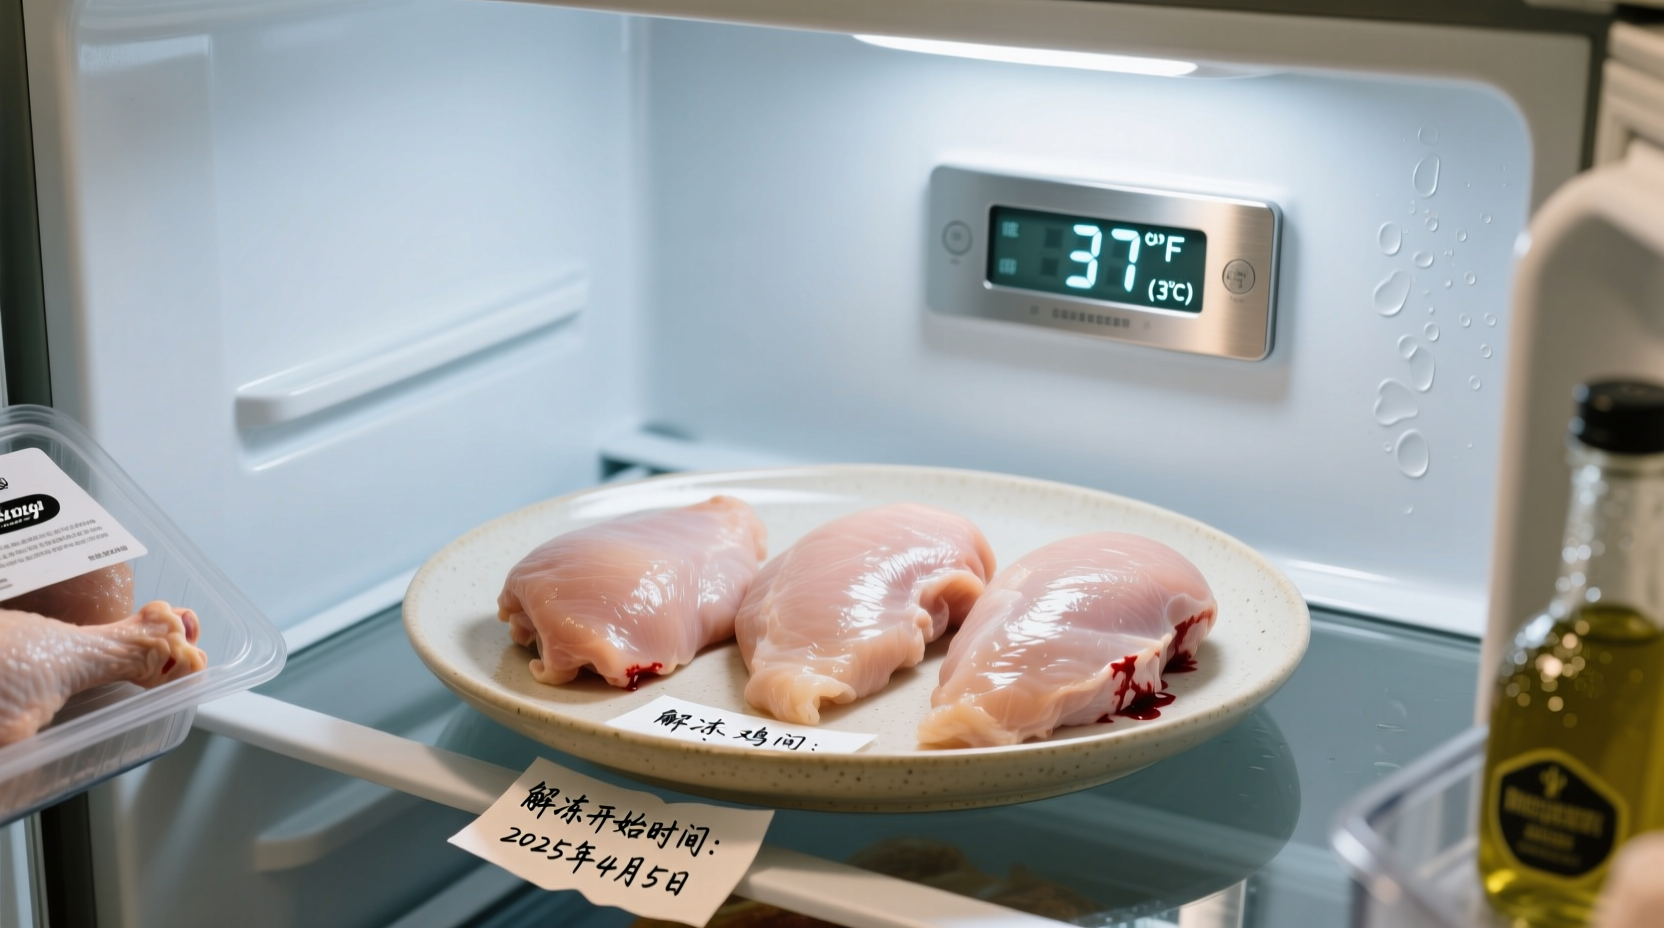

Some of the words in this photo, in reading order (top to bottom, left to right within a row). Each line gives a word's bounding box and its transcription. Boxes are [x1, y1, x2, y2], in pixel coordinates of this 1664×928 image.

[521, 781, 720, 858] 解冻开始时间:
[500, 827, 689, 896] 2025年4月5日
